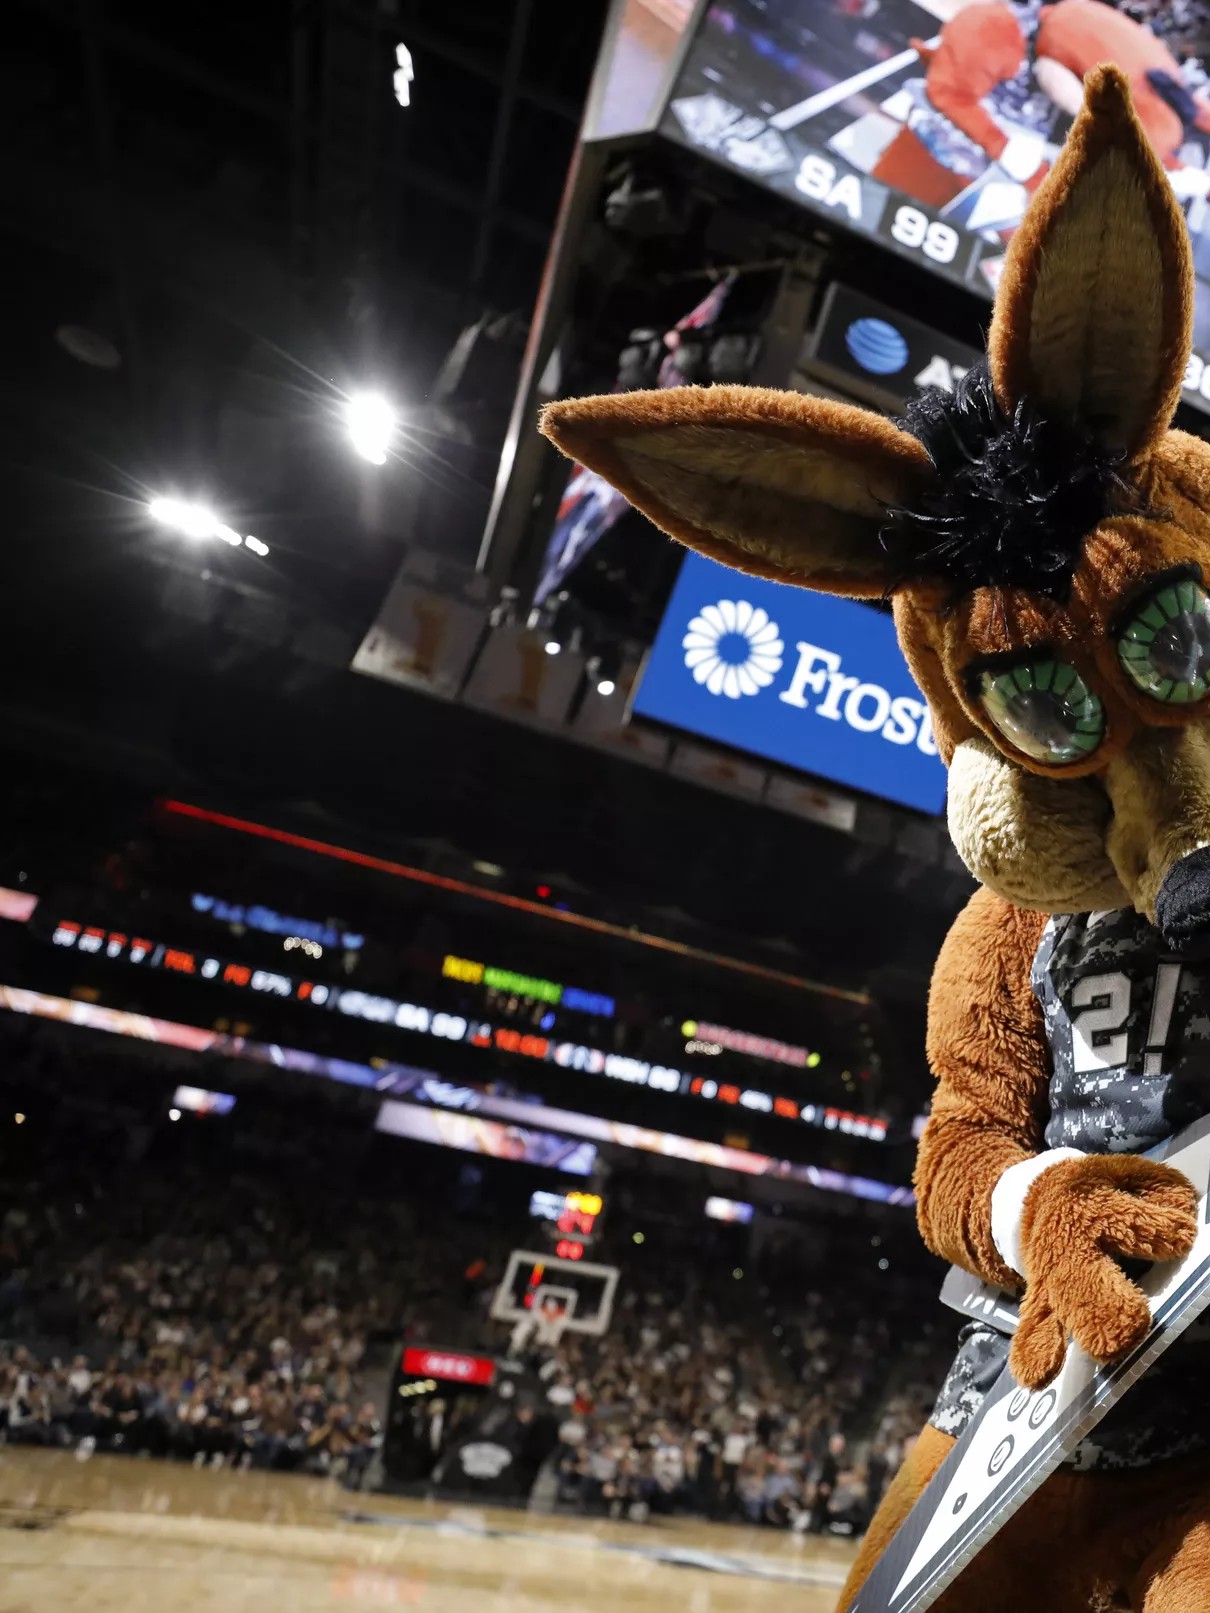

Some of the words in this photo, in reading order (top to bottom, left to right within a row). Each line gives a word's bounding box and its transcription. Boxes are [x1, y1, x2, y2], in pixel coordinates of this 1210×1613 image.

[795, 154, 864, 220] SA
[891, 205, 960, 264] 99
[779, 641, 940, 756] Frost
